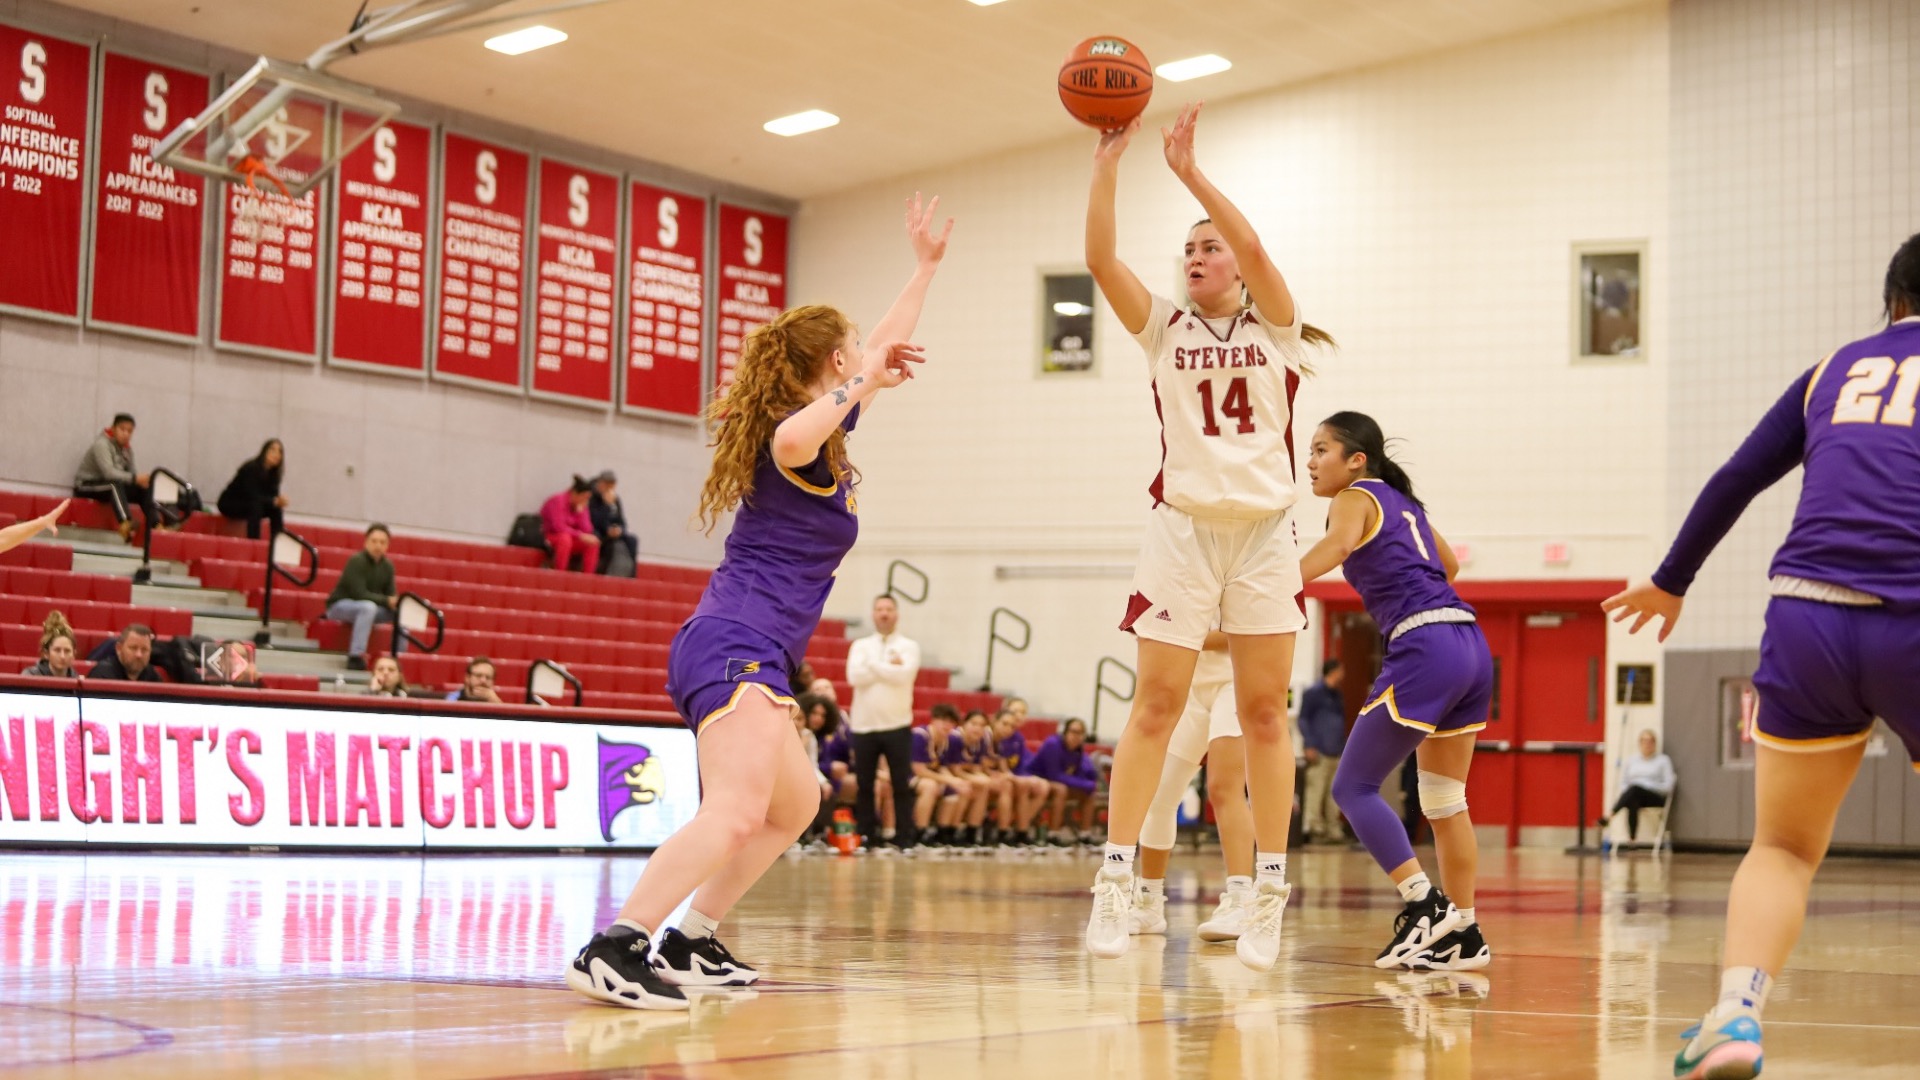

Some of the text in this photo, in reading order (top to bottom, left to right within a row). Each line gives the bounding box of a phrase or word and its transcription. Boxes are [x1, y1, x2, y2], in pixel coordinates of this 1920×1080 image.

[20, 41, 47, 102] S
[1072, 67, 1138, 90] THE ROCK
[5, 105, 56, 129] SOFTBALL
[143, 72, 168, 131] S
[0, 123, 79, 158] NFERENCE
[373, 127, 396, 183] S
[0, 145, 79, 180] AMPIONS
[130, 152, 175, 182] NCAA
[475, 150, 497, 205] S
[13, 174, 42, 195] 2022
[106, 171, 198, 206] APPEARANCES
[568, 174, 590, 228] S
[106, 194, 164, 220] 2021 2022
[361, 201, 403, 229] NCAA
[658, 196, 679, 248] S
[343, 220, 423, 251] APPEARANCES
[445, 234, 520, 271] CHAMPIONS
[744, 217, 763, 266] S
[1175, 344, 1267, 370] STEVENS
[1197, 377, 1255, 437] 14
[1831, 355, 1920, 427] 21
[1402, 511, 1430, 560] 1
[0, 714, 570, 829] NIGHT'S MATCHUP
